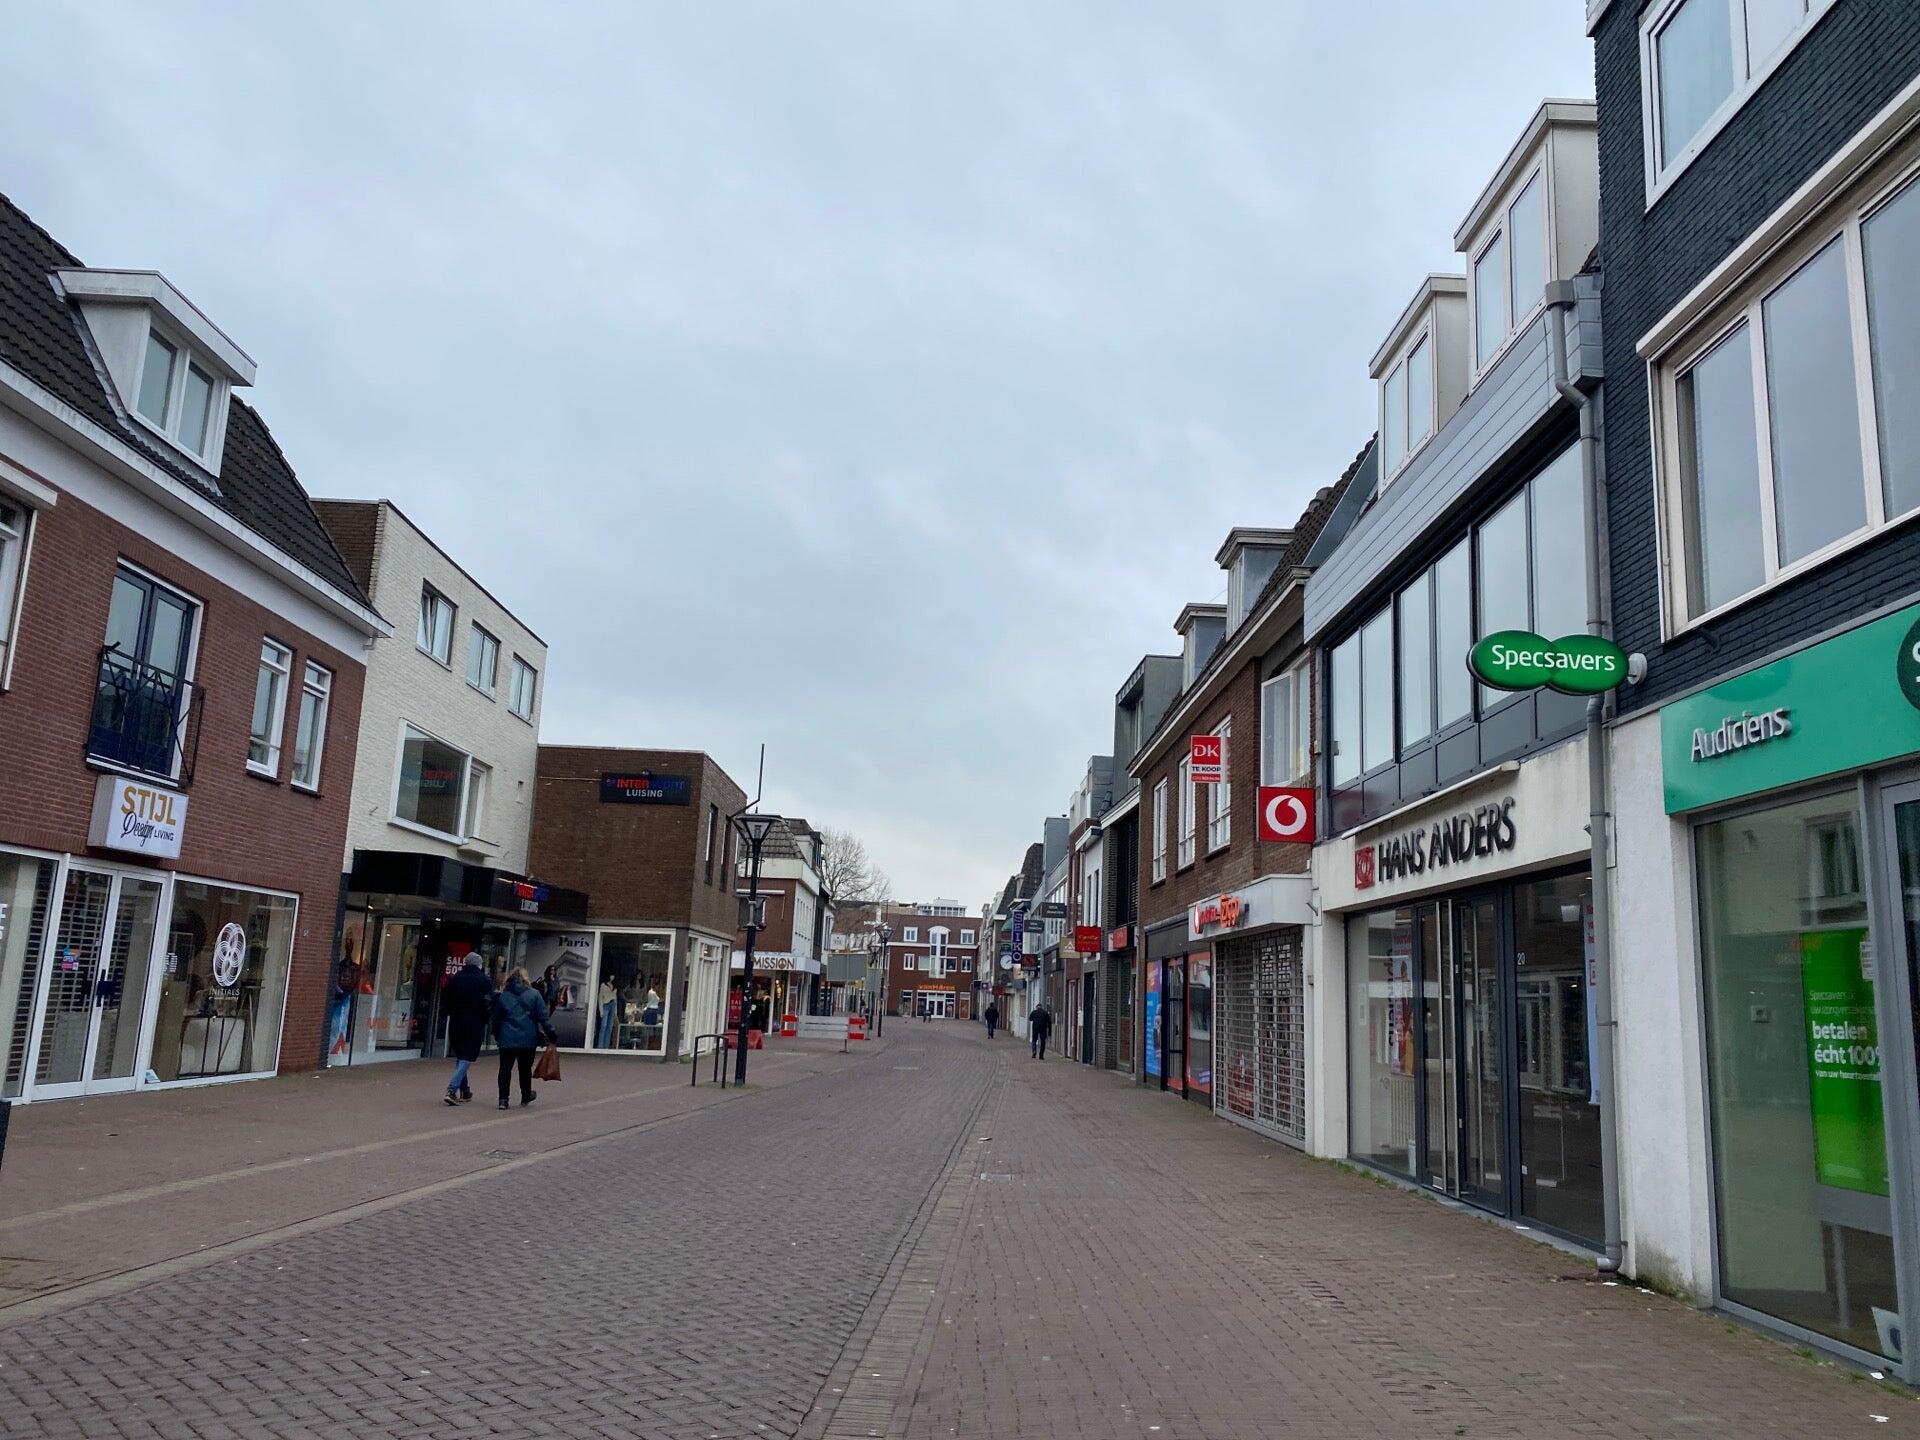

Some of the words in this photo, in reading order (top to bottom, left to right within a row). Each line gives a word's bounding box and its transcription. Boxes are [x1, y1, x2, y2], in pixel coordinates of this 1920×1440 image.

[1491, 644, 1615, 671] Specsavers
[1691, 706, 1792, 762] Audiciens
[1193, 744, 1219, 757] DK
[626, 789, 663, 797] LUISING
[121, 786, 176, 826] STIJL
[121, 811, 154, 847] Design
[154, 829, 174, 841] LIVING
[1378, 827, 1426, 882] HANS
[1428, 795, 1516, 870] ANDERS
[558, 936, 590, 947] Paris
[1012, 913, 1023, 961] SEIKO
[1517, 952, 1526, 965] 20
[1812, 1021, 1868, 1040] betalen
[1814, 1044, 1846, 1065] écht
